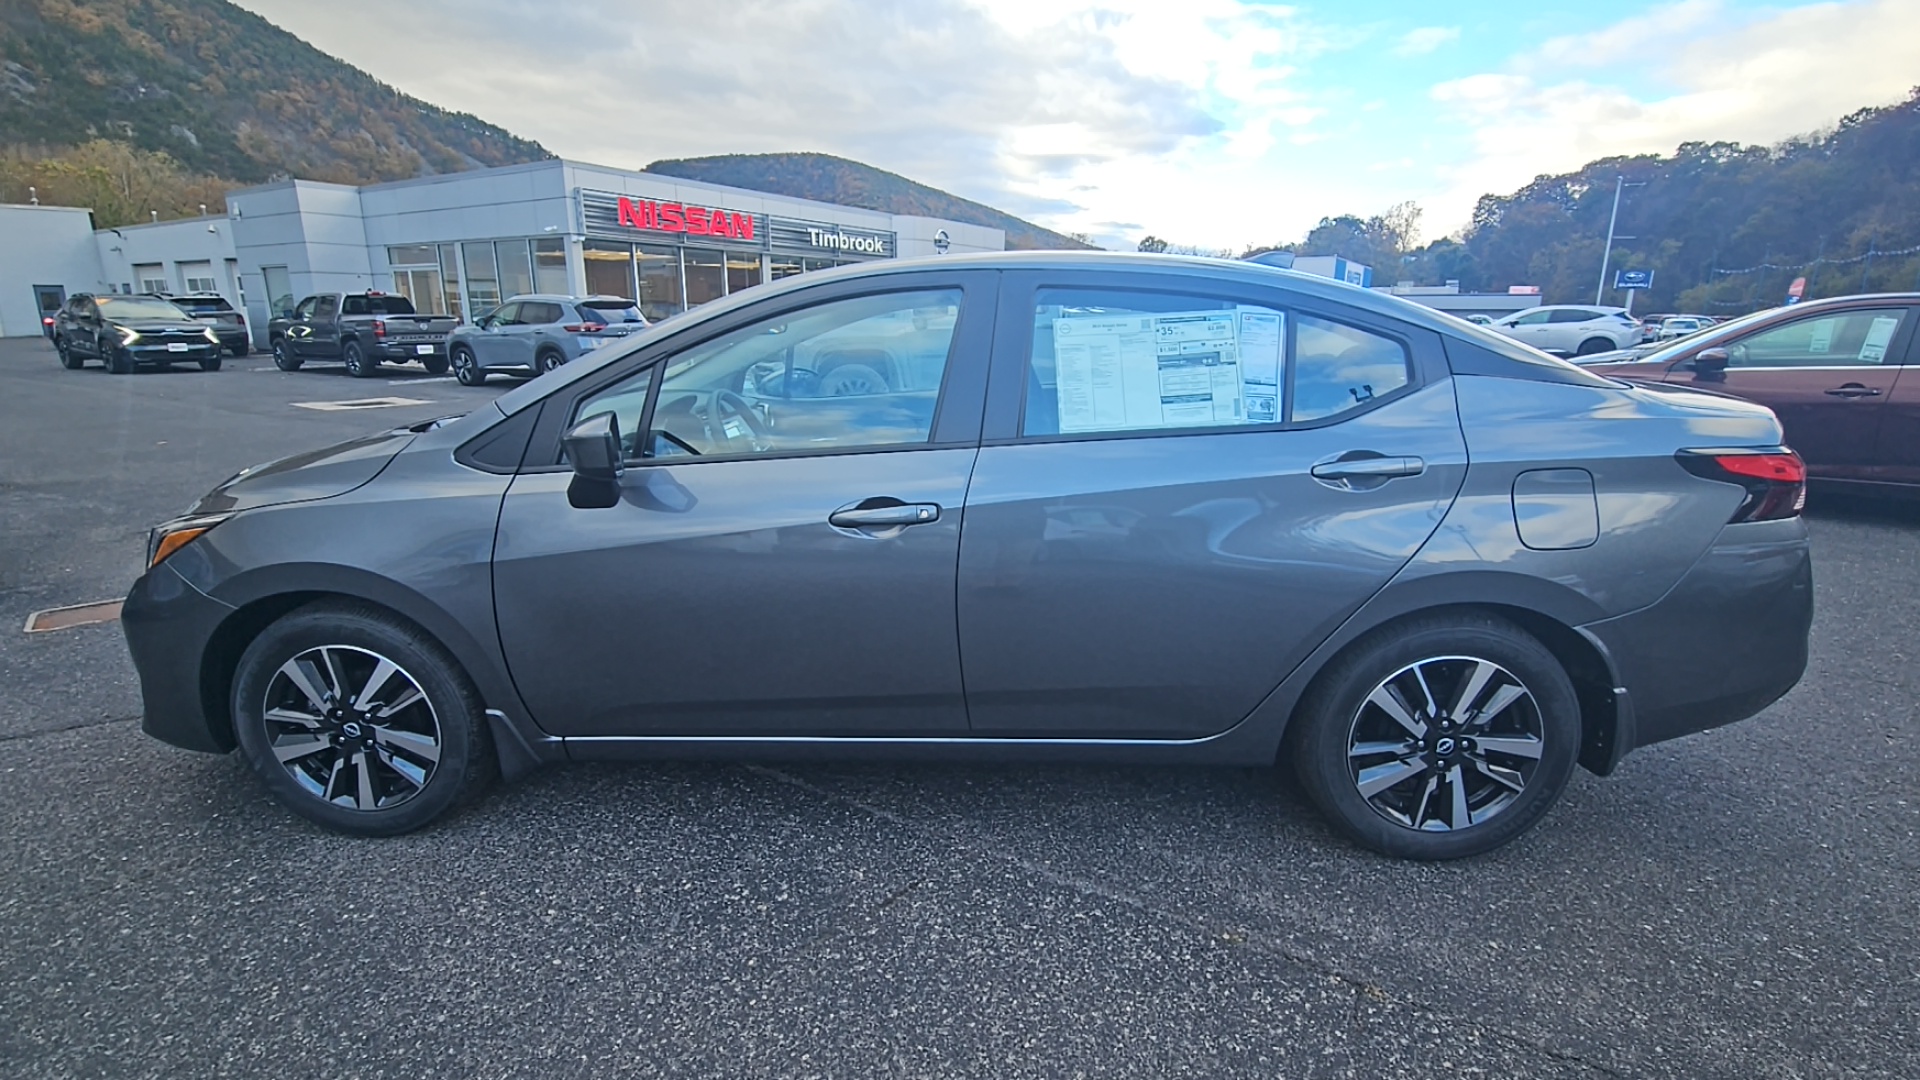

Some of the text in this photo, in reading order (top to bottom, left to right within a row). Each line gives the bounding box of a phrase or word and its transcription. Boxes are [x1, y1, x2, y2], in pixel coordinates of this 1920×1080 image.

[617, 196, 754, 240] NISSAN
[806, 226, 884, 254] Timbrook
[1160, 326, 1174, 336] 35
